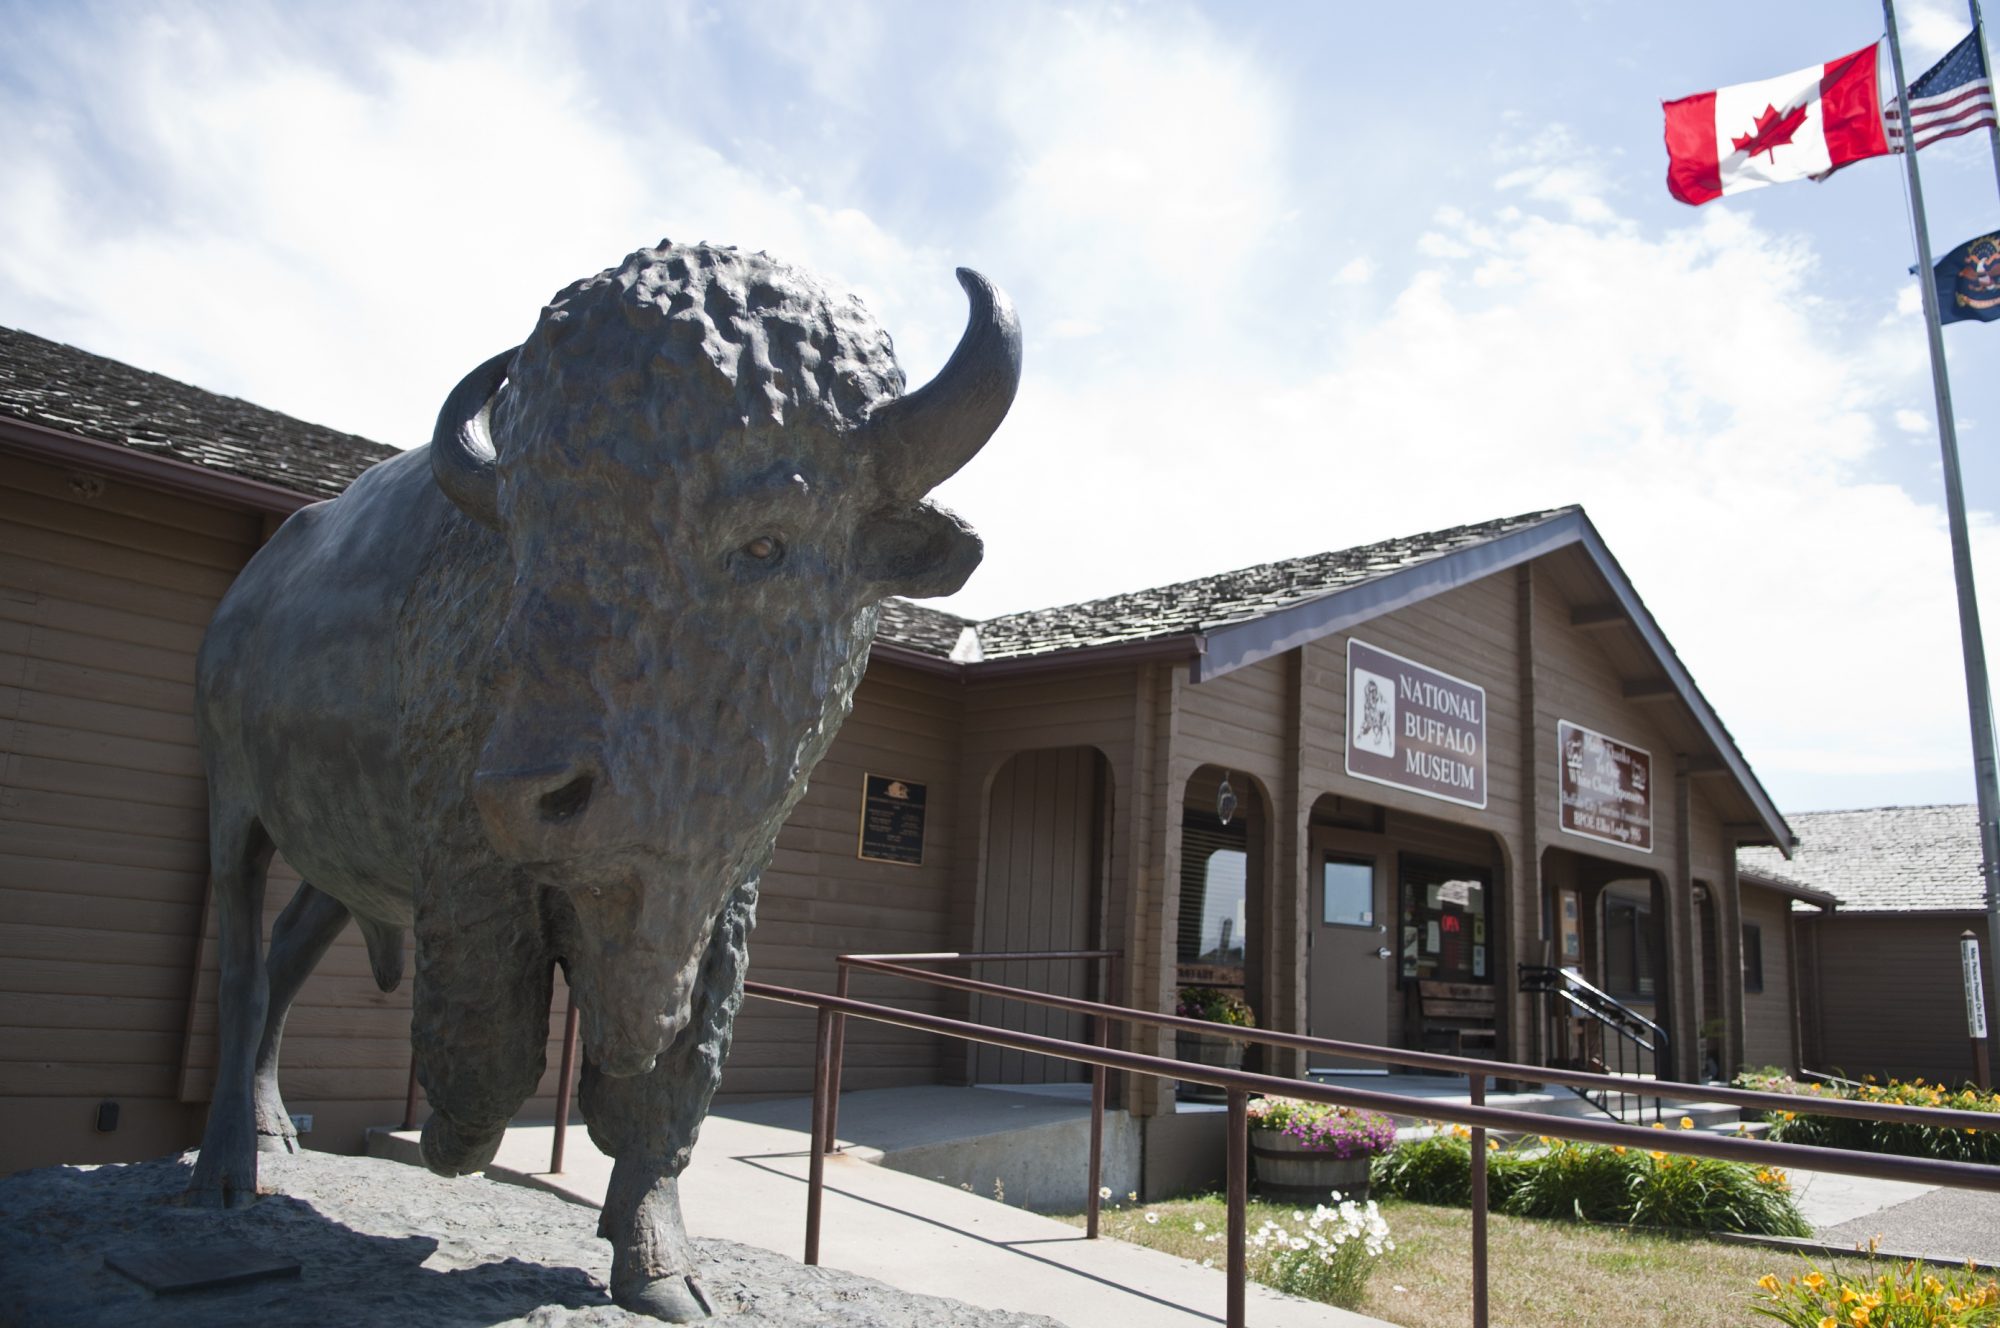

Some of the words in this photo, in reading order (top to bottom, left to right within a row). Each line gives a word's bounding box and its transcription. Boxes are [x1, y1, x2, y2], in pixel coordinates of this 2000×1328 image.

[1400, 673, 1480, 725] NATIONAL
[1405, 712, 1476, 756] BUFFALO
[1406, 748, 1475, 790] MUSEUM
[1569, 767, 1591, 789] White
[1592, 775, 1614, 796] Cloud
